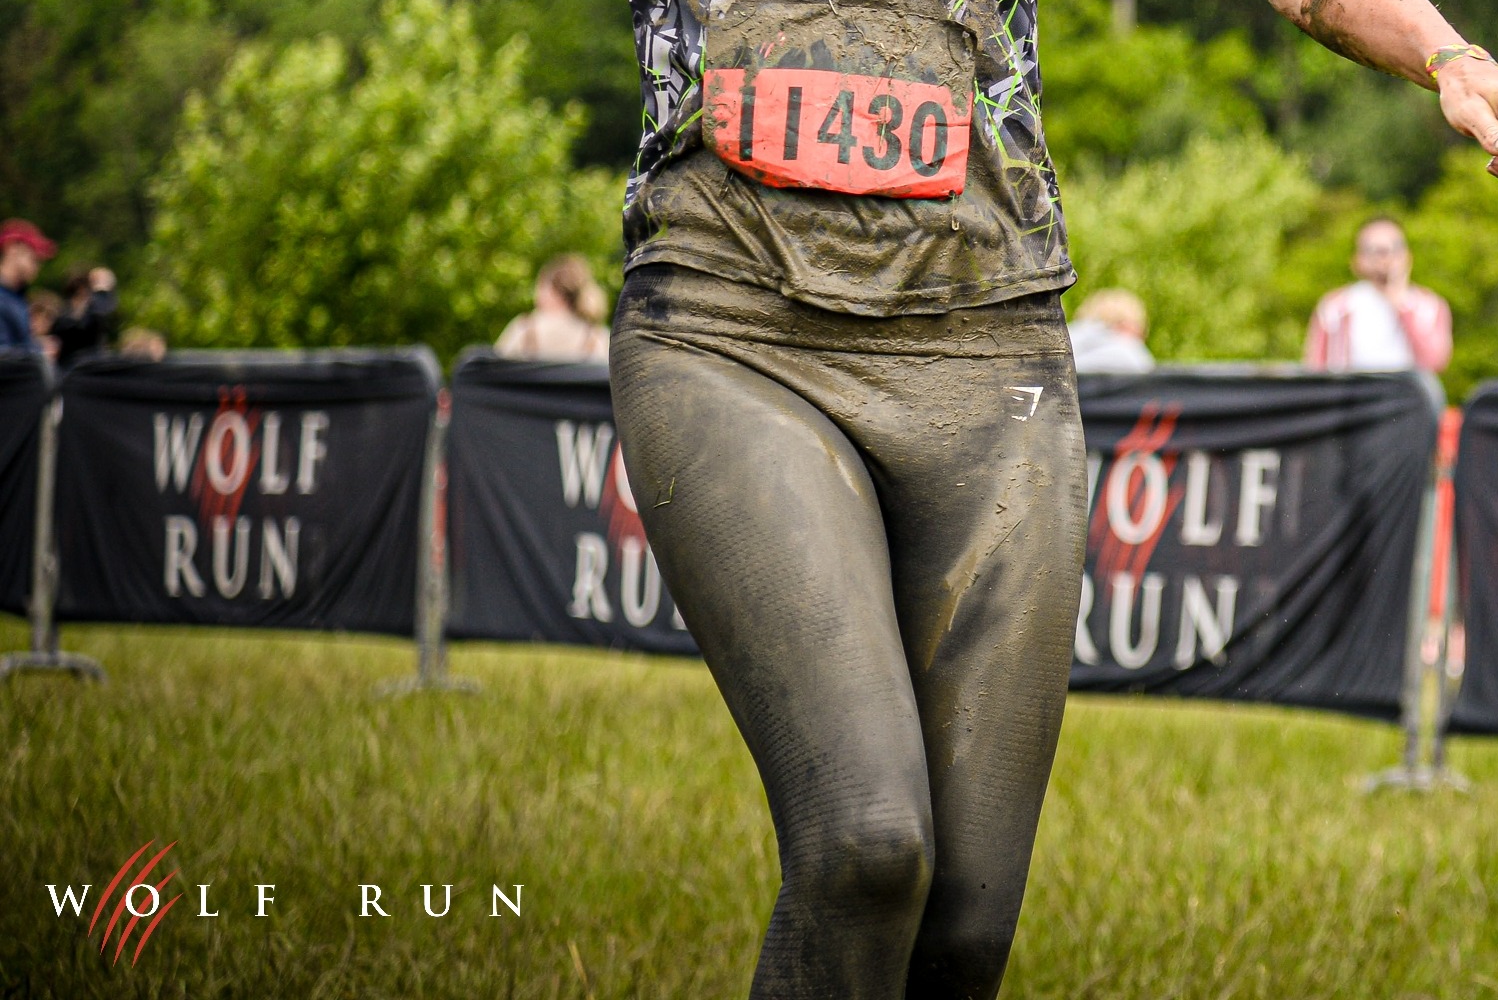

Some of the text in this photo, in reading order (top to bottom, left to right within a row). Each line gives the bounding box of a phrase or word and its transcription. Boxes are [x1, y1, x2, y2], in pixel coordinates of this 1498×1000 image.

[738, 86, 948, 178] 11430
[154, 410, 330, 495] WOLF
[1087, 449, 1282, 546] OLF
[164, 514, 300, 600] RUN
[567, 531, 688, 630] RU
